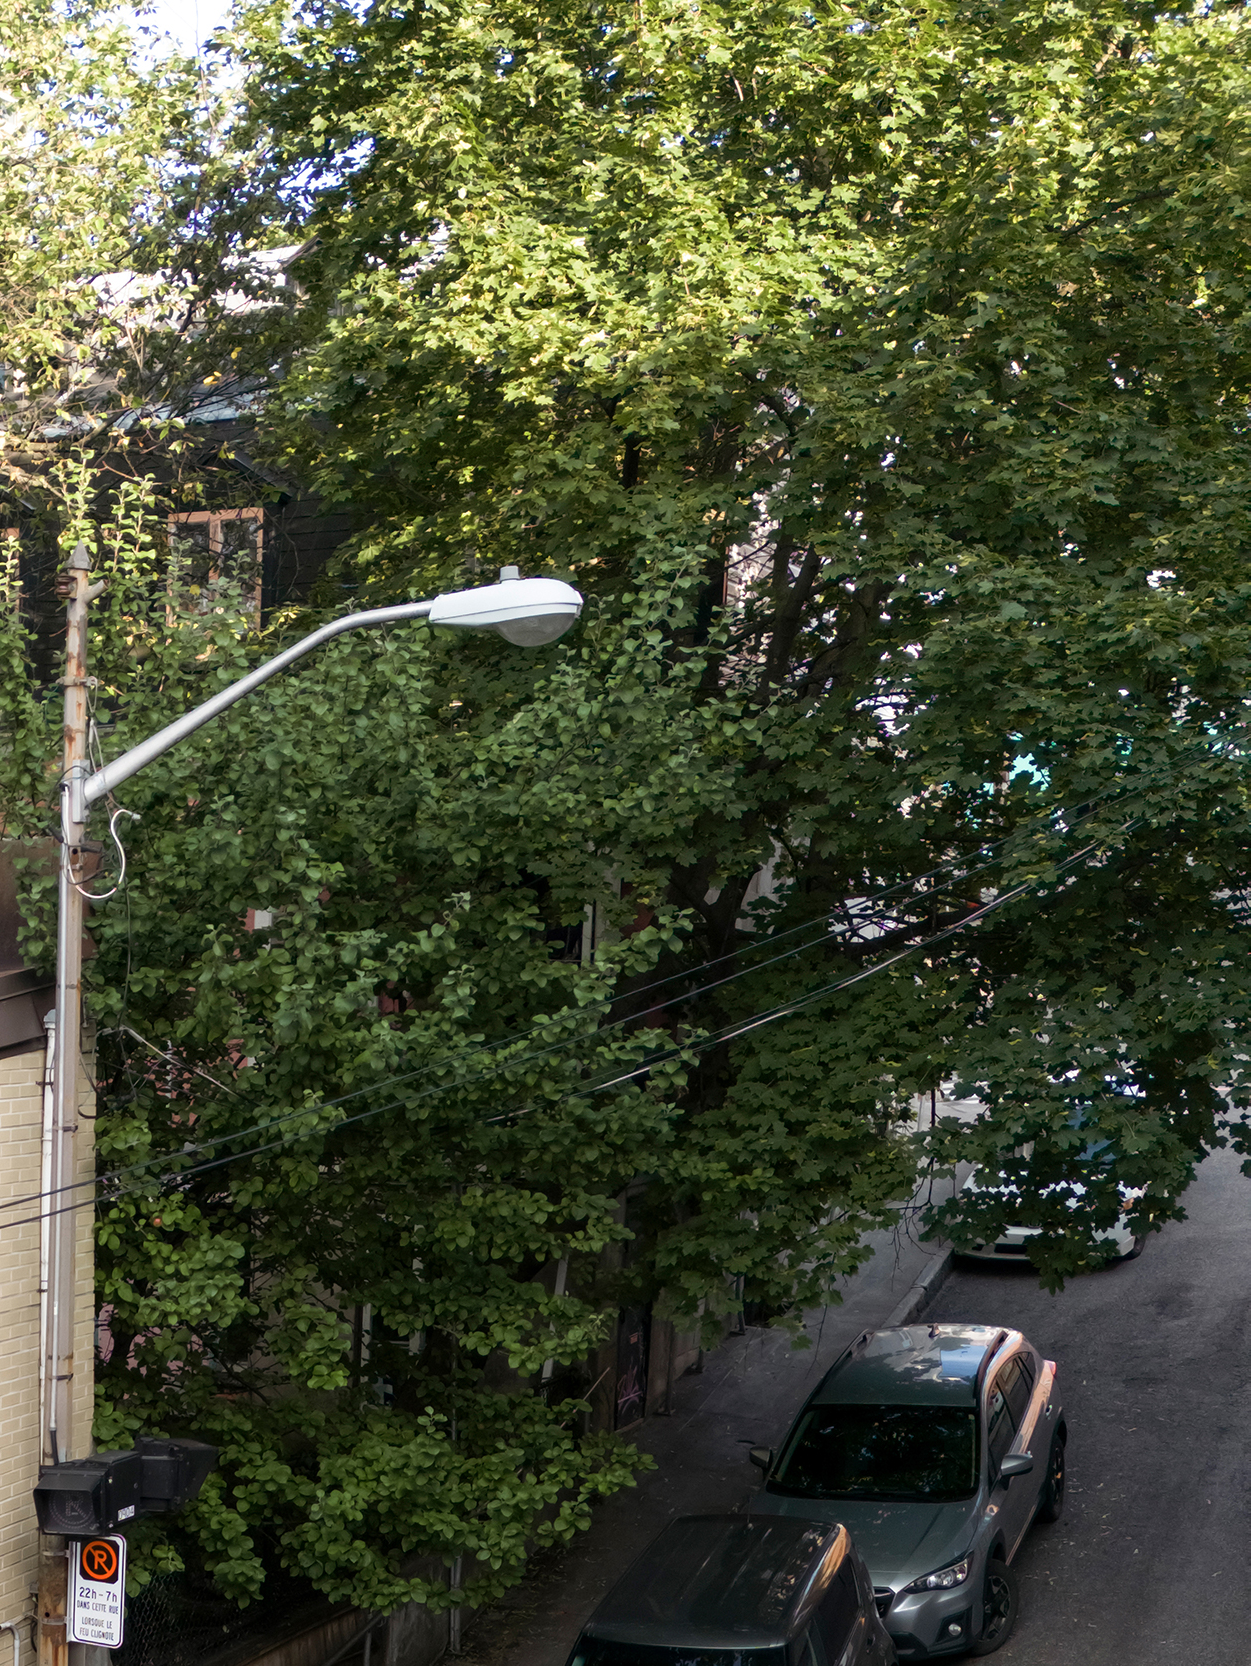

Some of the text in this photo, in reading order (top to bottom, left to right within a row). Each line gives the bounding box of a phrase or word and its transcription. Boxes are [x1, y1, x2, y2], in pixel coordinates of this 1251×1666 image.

[79, 1586, 97, 1600] 22h
[106, 1590, 117, 1603] 7h
[77, 1599, 119, 1615] DANS CETTE RUE
[81, 1616, 113, 1630] LORSQUE LE
[79, 1627, 114, 1642] FEU CLIGNOTE
